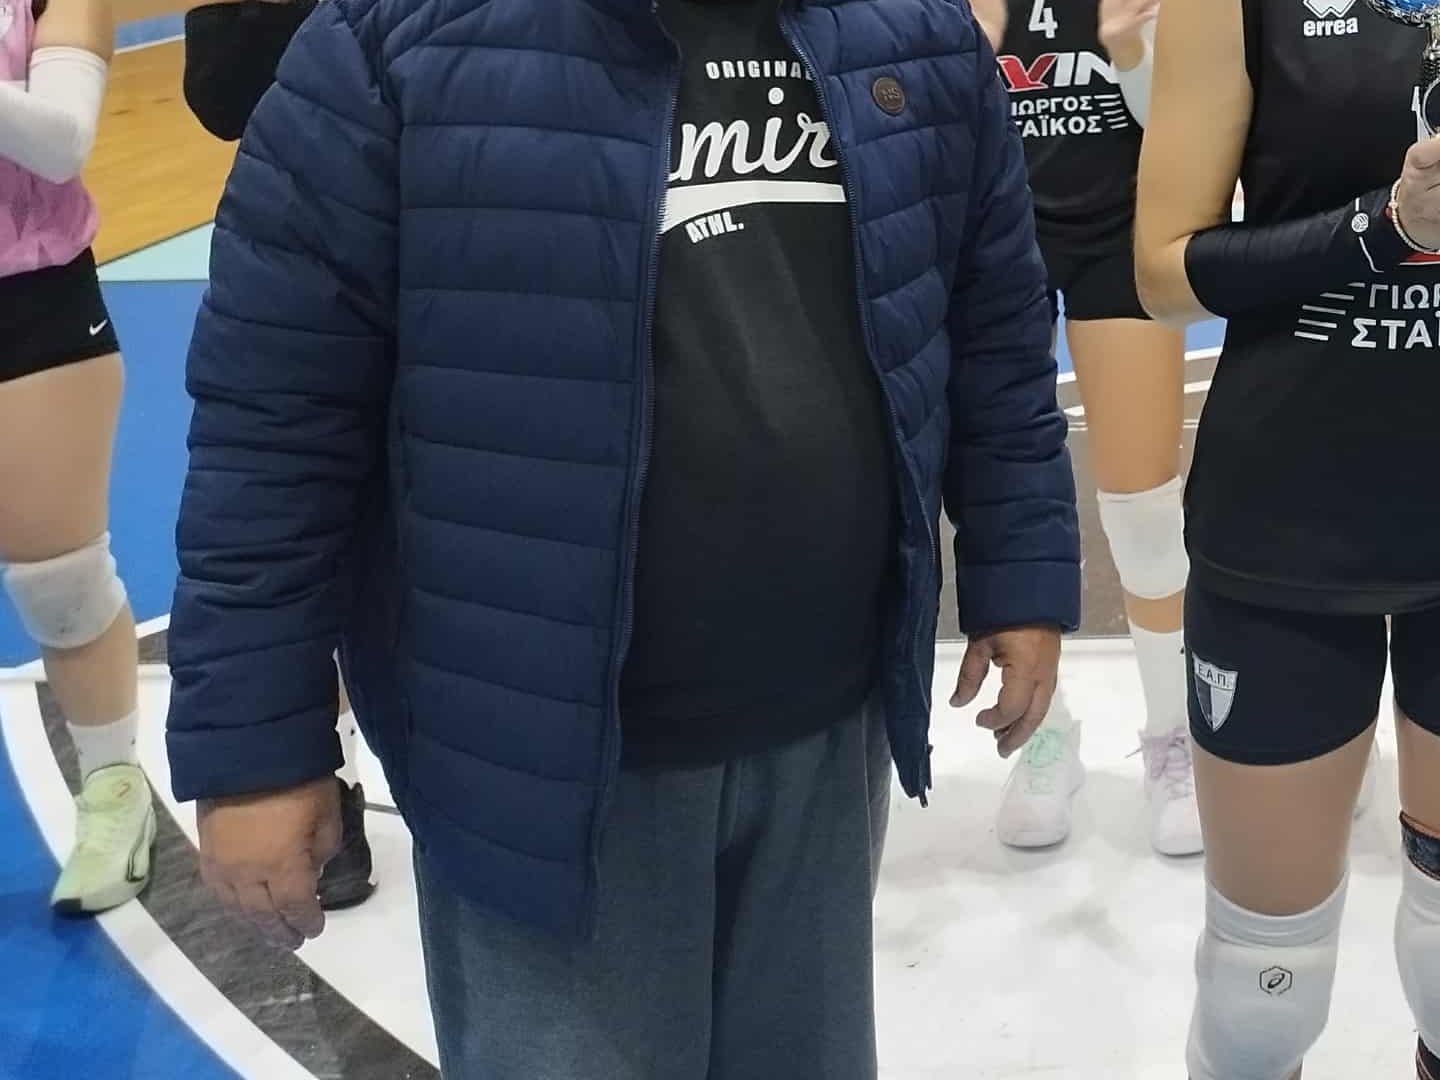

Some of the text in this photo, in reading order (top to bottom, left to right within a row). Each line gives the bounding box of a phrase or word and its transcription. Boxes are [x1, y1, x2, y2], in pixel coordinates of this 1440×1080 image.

[1303, 17, 1359, 37] errea
[996, 51, 1120, 92] VIN
[1011, 95, 1093, 116] ΙΩΡΓΟΣ
[1016, 115, 1103, 138] ΑΪΚΟΣ
[686, 211, 745, 244] ATHL.
